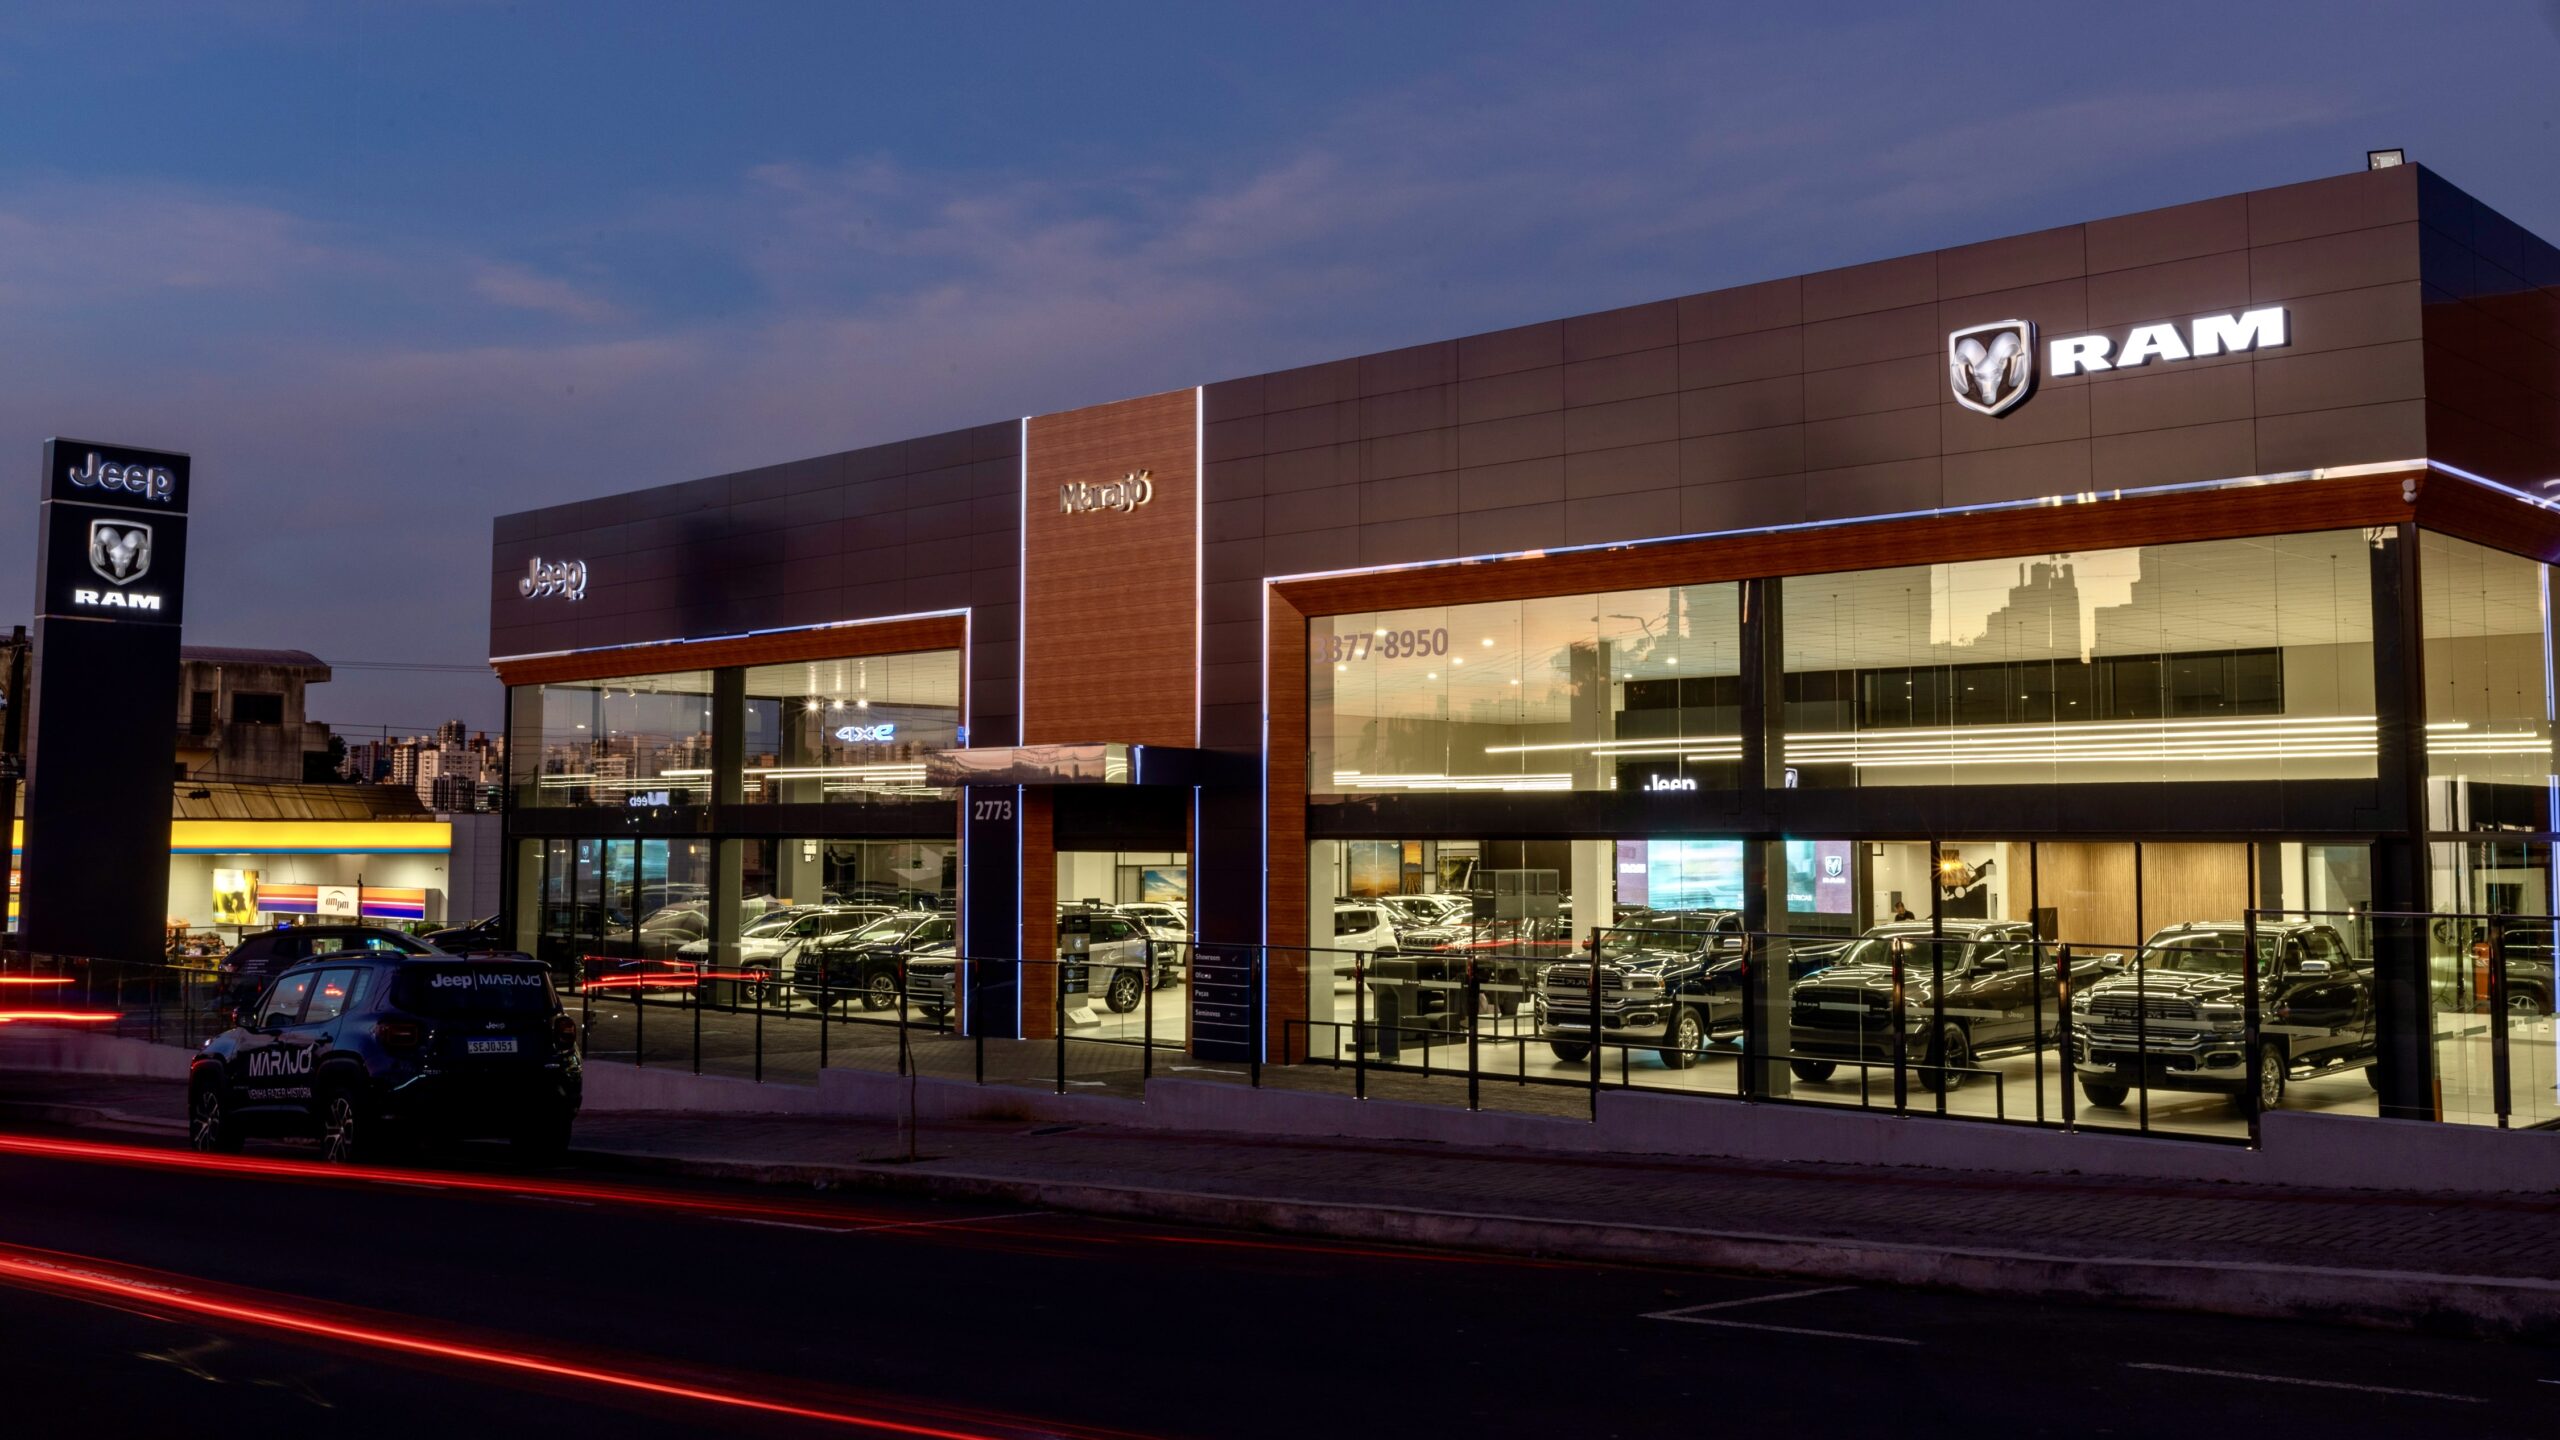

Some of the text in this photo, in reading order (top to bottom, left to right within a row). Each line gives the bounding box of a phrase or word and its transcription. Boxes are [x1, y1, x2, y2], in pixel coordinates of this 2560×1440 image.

[2050, 306, 2287, 376] RAM
[69, 452, 176, 500] Jeep
[1059, 469, 1152, 514] Marajó
[518, 557, 587, 600] Jeep
[75, 589, 160, 609] RAM
[975, 800, 1013, 821] 2773
[431, 973, 472, 989] Jeep
[249, 1045, 313, 1077] MARAJÓ
